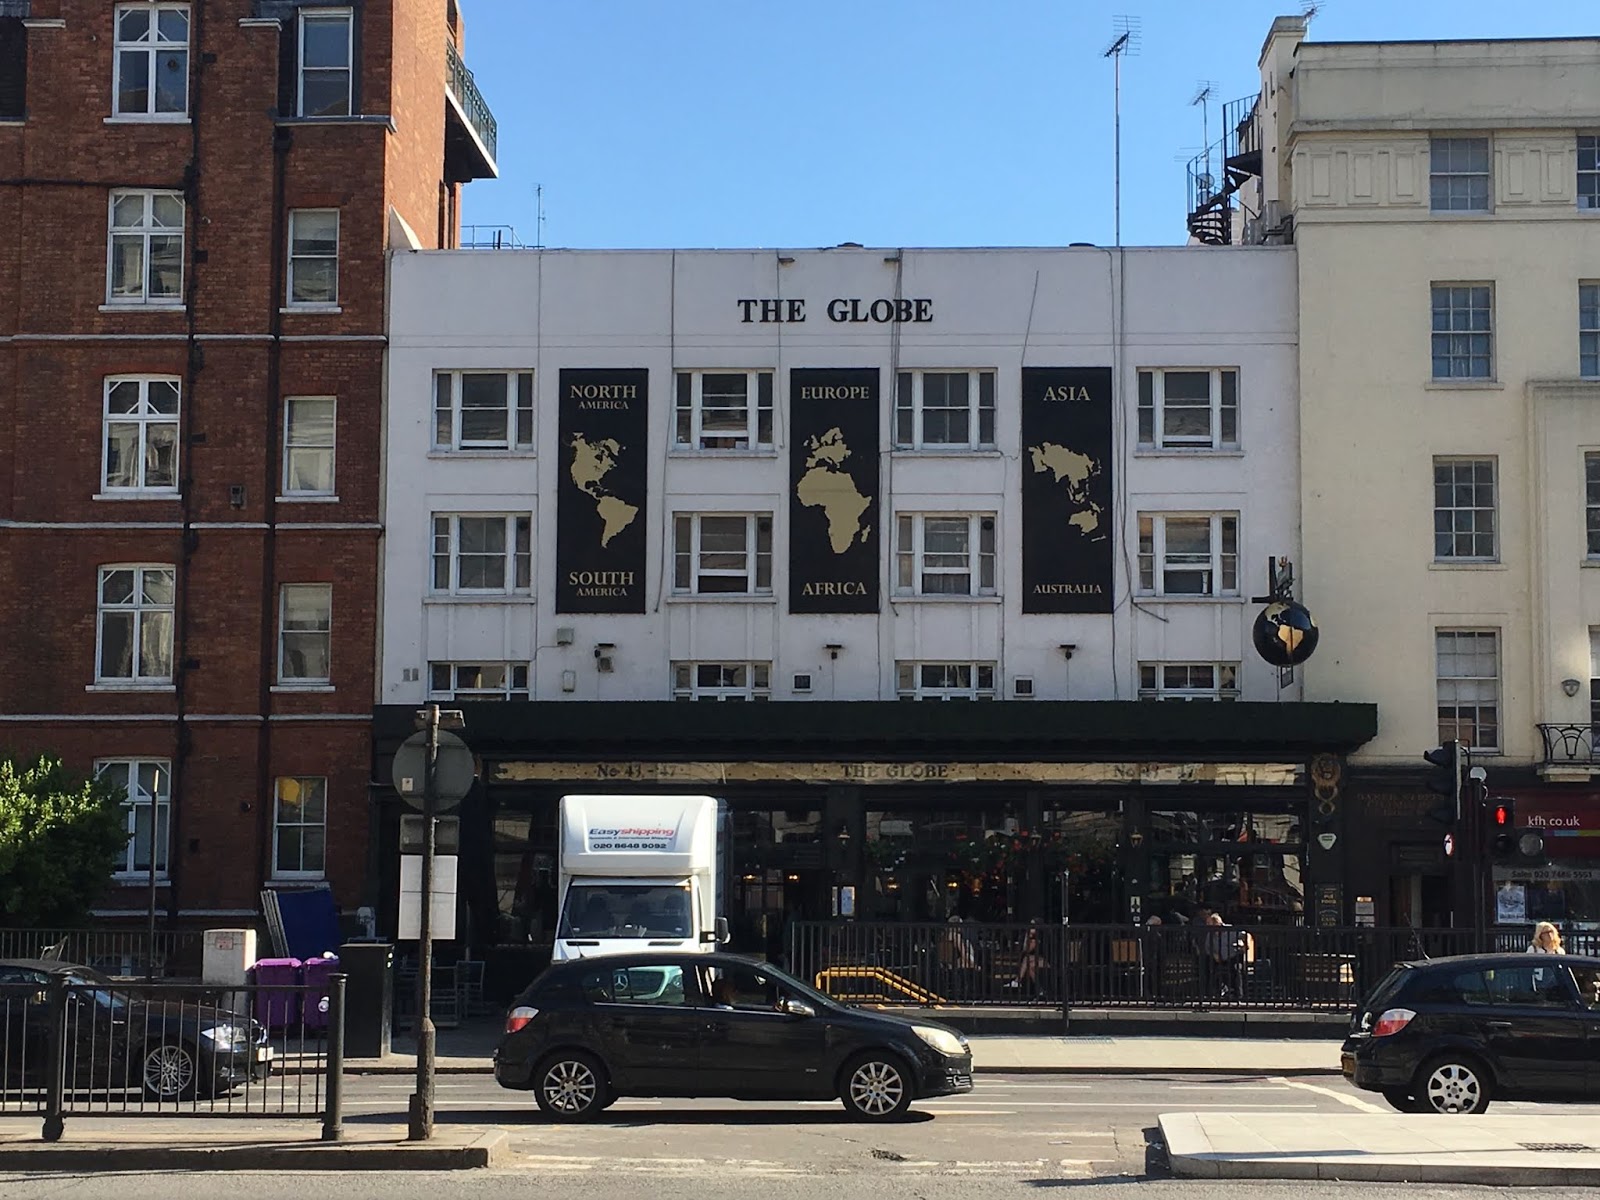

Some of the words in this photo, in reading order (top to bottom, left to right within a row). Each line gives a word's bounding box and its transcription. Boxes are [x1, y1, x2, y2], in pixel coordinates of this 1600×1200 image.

[737, 299, 807, 323] THE
[827, 298, 934, 323] GLOBE
[570, 384, 637, 399] NORTH
[801, 386, 870, 400] EUROPE
[1043, 386, 1091, 401] ASIA
[578, 401, 629, 410] AMERICA
[569, 571, 634, 586] SOUTH
[576, 588, 628, 597] AMERICA
[802, 582, 867, 596] AFRICA
[1033, 584, 1102, 594] AUSTRALIA
[841, 764, 880, 778] THE
[886, 764, 949, 779] GLOBE
[1528, 816, 1581, 827] kfh.co.uk
[589, 828, 674, 836] Easyshipping
[1534, 870, 1550, 878] 020
